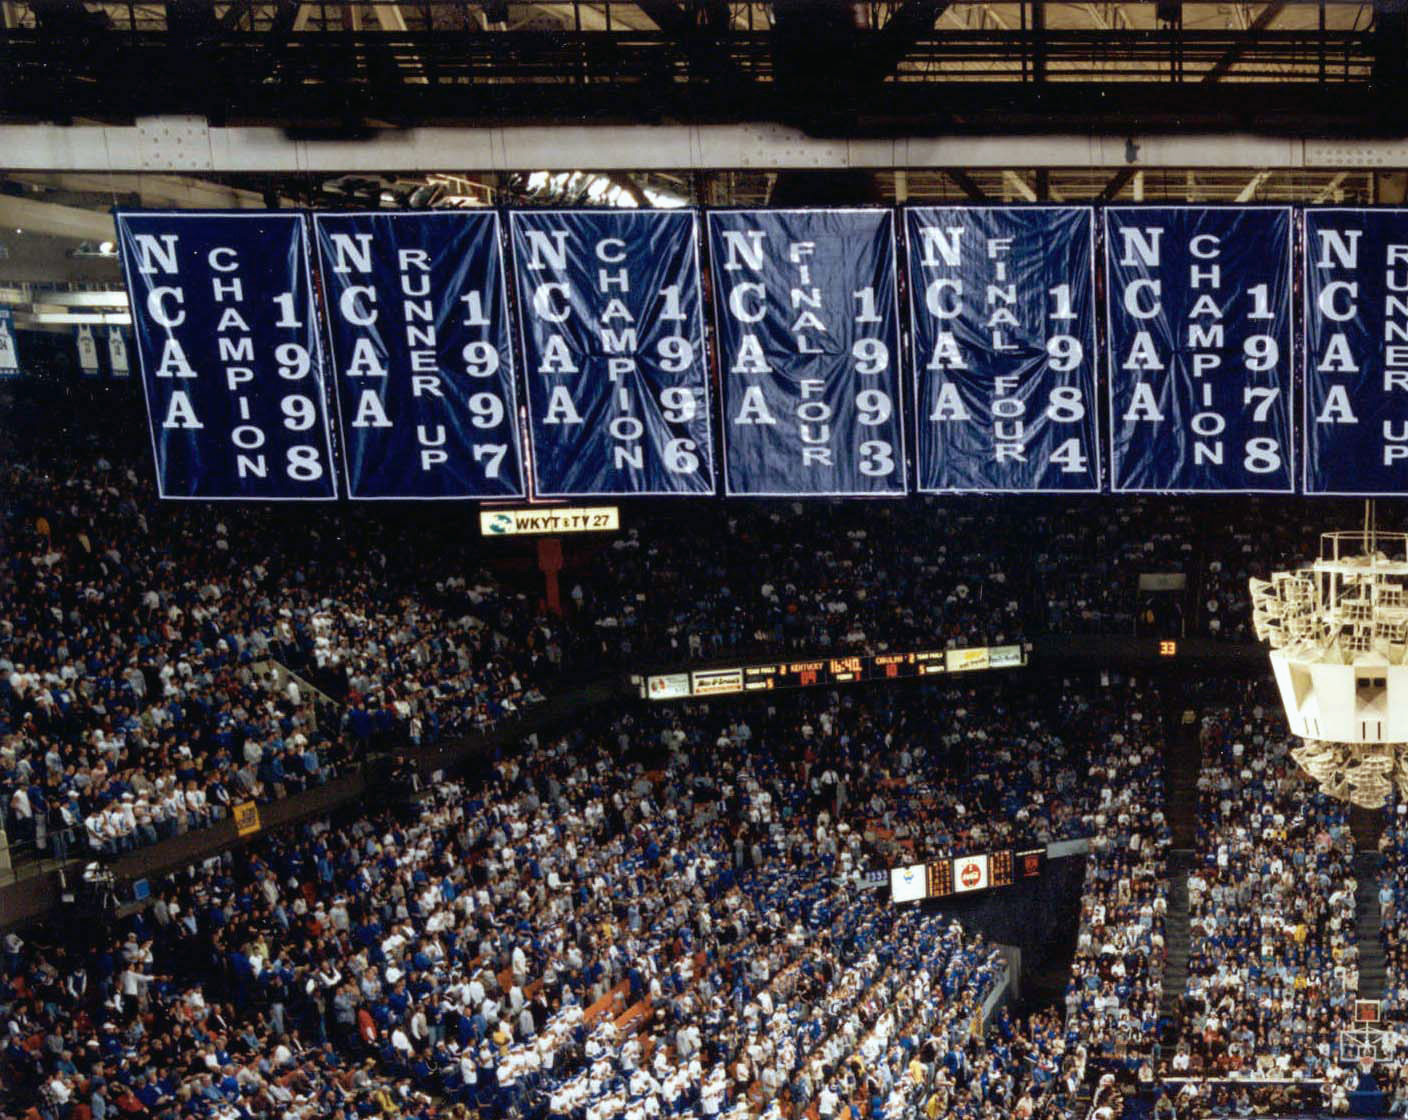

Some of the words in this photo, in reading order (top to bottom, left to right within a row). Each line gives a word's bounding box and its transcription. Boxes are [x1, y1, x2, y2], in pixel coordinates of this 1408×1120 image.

[135, 233, 203, 428] NCAA
[208, 248, 267, 478] CHAMPION
[273, 293, 323, 481] 1998
[333, 233, 393, 428] NCAA
[398, 249, 443, 397] RUNNER
[460, 290, 509, 478] 1997
[526, 231, 583, 424] NCAA
[596, 239, 643, 469] CHAMPION
[657, 286, 700, 474] 1996
[722, 230, 776, 424] NCAA
[790, 242, 827, 354] FINAL
[853, 287, 895, 476] 1993
[919, 227, 970, 421] NCAA
[986, 238, 1019, 350] FINAL
[1046, 284, 1087, 473] 1984
[1120, 227, 1165, 421] NCAA
[1188, 235, 1225, 465] CHAMPION
[1242, 284, 1281, 473] 1978
[1315, 229, 1362, 423] NCAA
[416, 425, 448, 470] UP
[798, 380, 832, 466] FOUR
[993, 376, 1027, 462] FOUR
[593, 514, 609, 527] 27
[790, 662, 824, 673] KENTUCKY
[1160, 642, 1176, 655] 33
